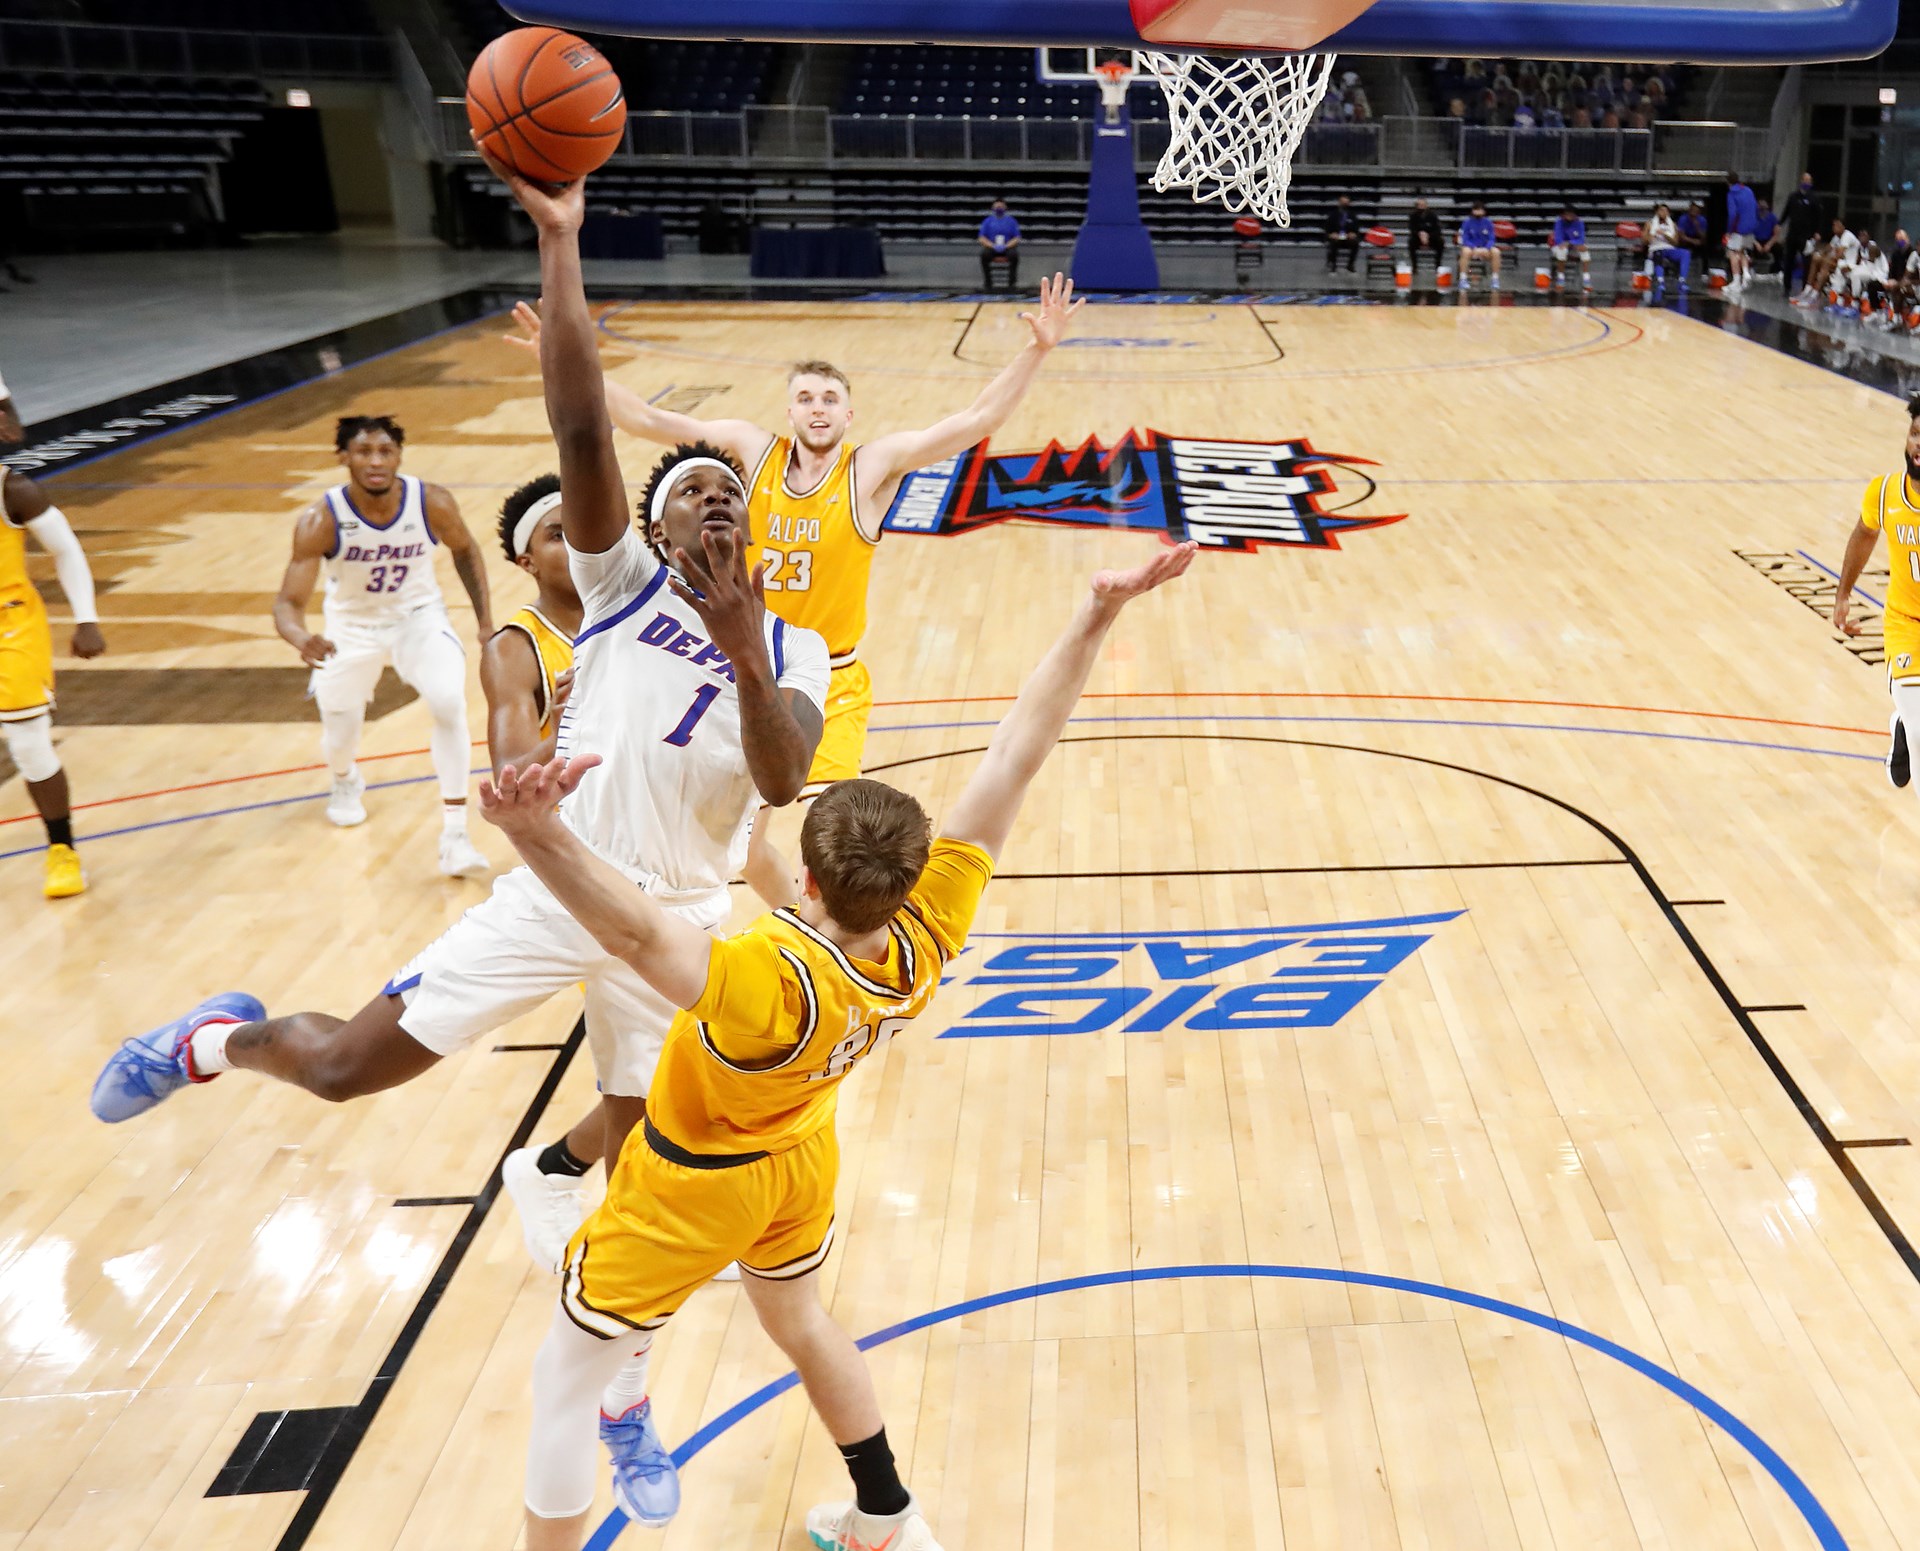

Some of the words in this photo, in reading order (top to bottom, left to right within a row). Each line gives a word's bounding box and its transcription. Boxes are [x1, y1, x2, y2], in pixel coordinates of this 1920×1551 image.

[1171, 440, 1310, 545] DEPAUL
[365, 564, 409, 592] 33
[762, 546, 814, 592] 23
[637, 611, 737, 684] DEPA
[662, 683, 721, 748] 1
[943, 934, 1432, 986] EAS
[937, 980, 1385, 1038] BIG
